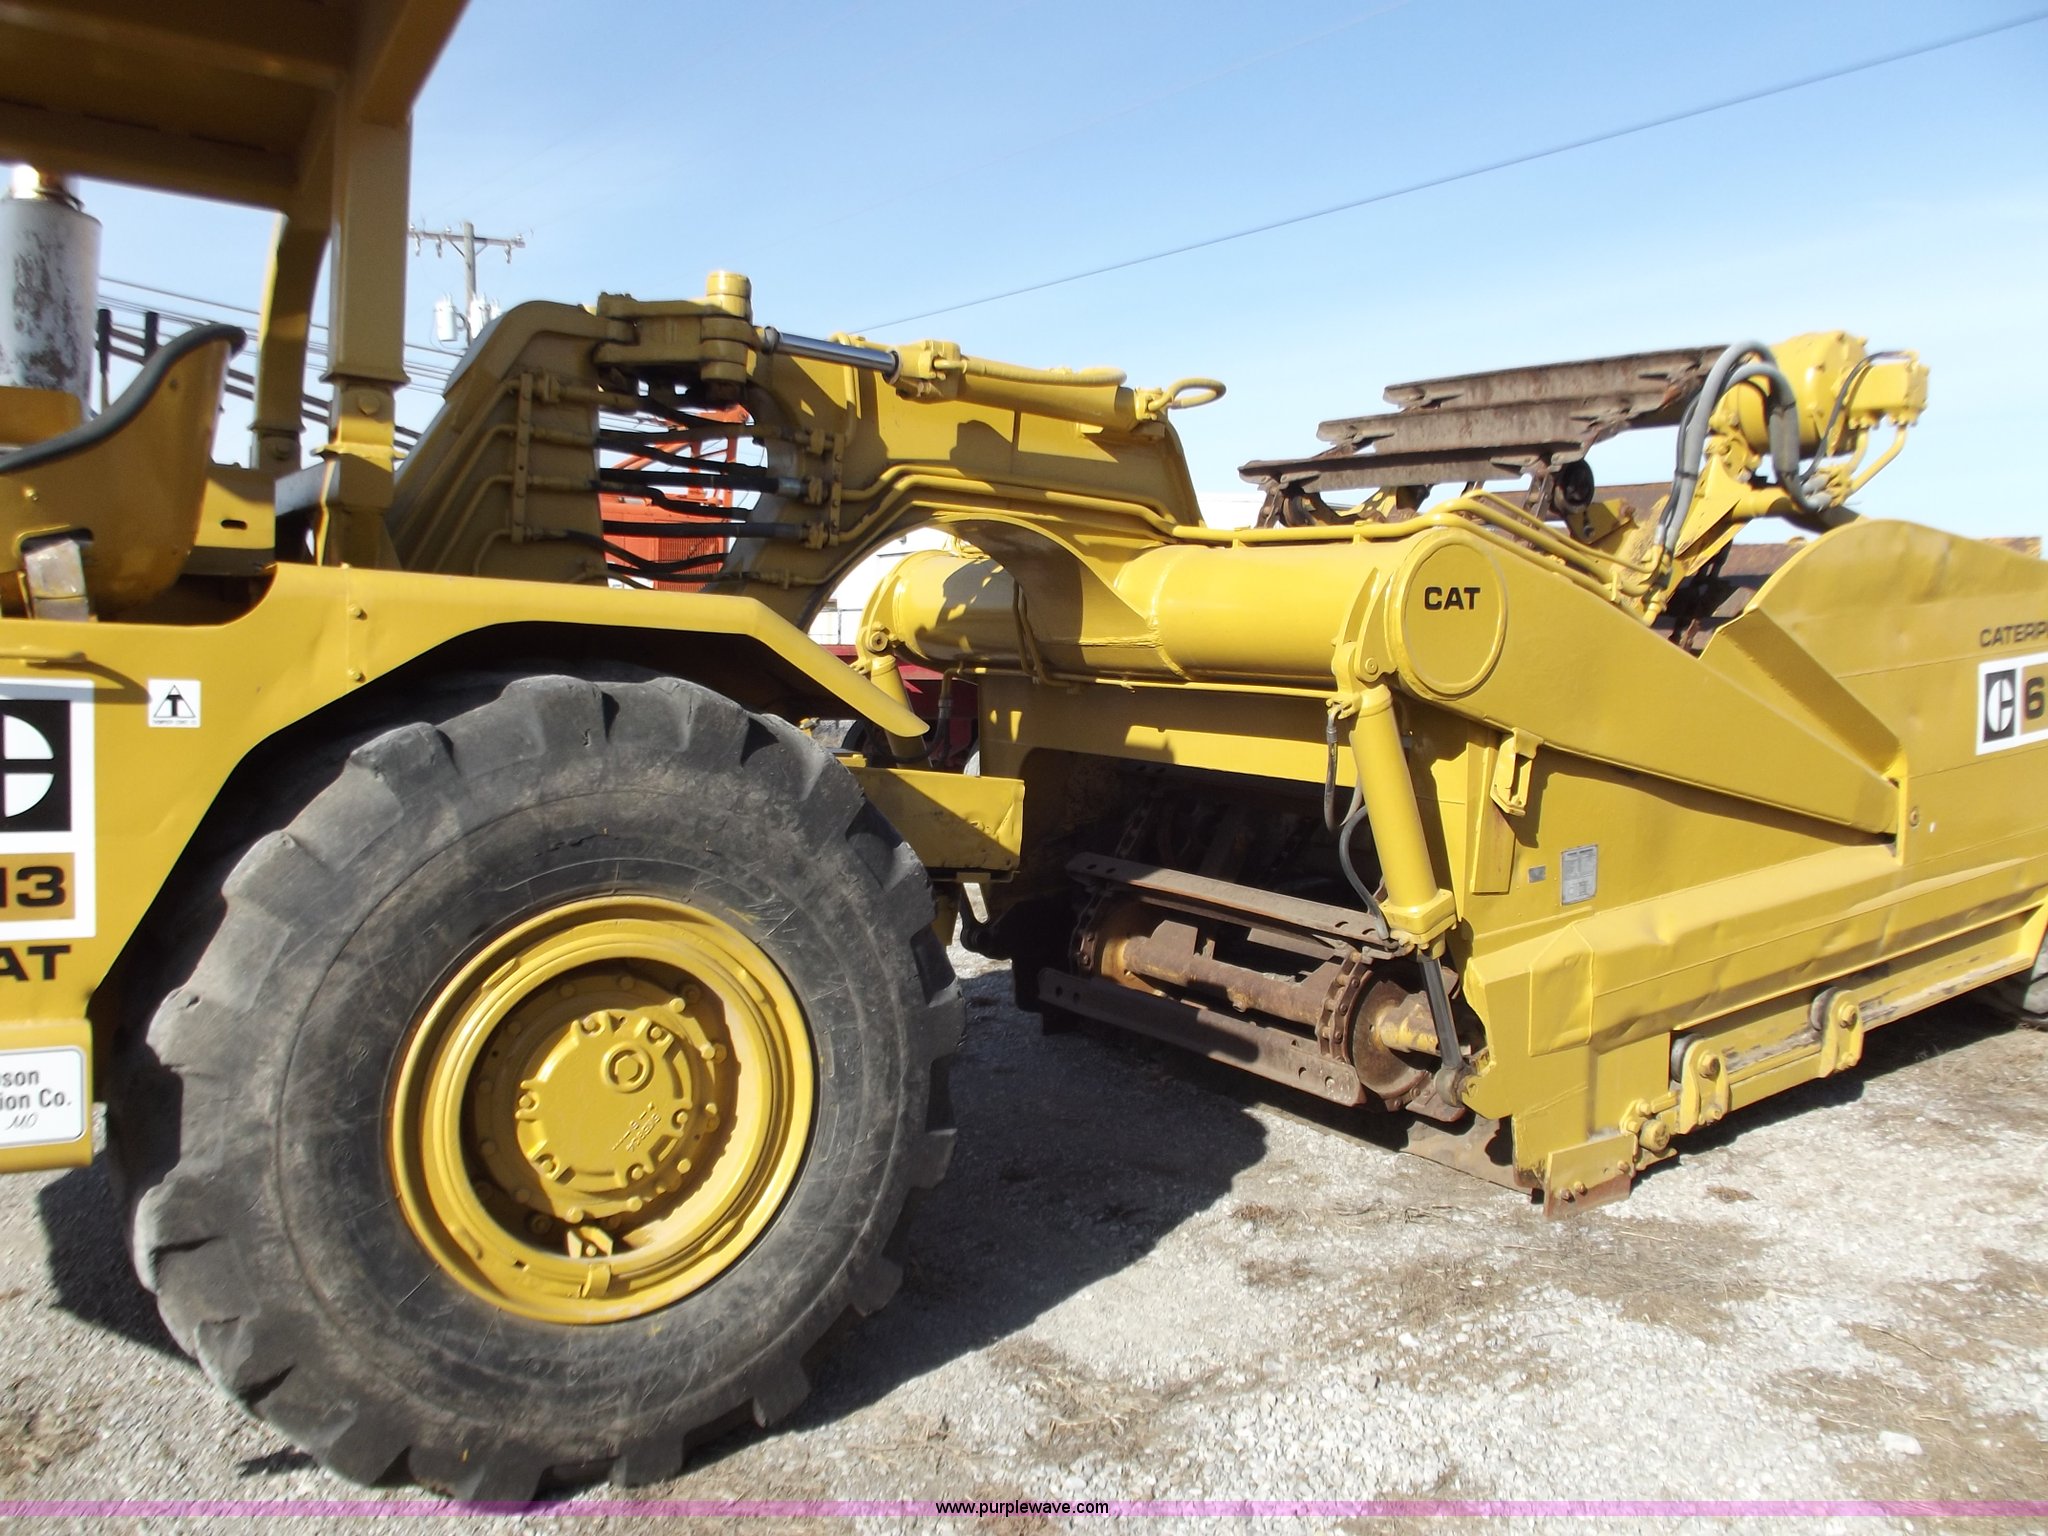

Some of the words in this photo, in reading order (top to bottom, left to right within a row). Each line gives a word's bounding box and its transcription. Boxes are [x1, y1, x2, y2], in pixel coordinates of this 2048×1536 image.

[1424, 586, 1481, 610] CAT
[0, 1070, 39, 1087] son
[39, 1088, 72, 1108] Co.
